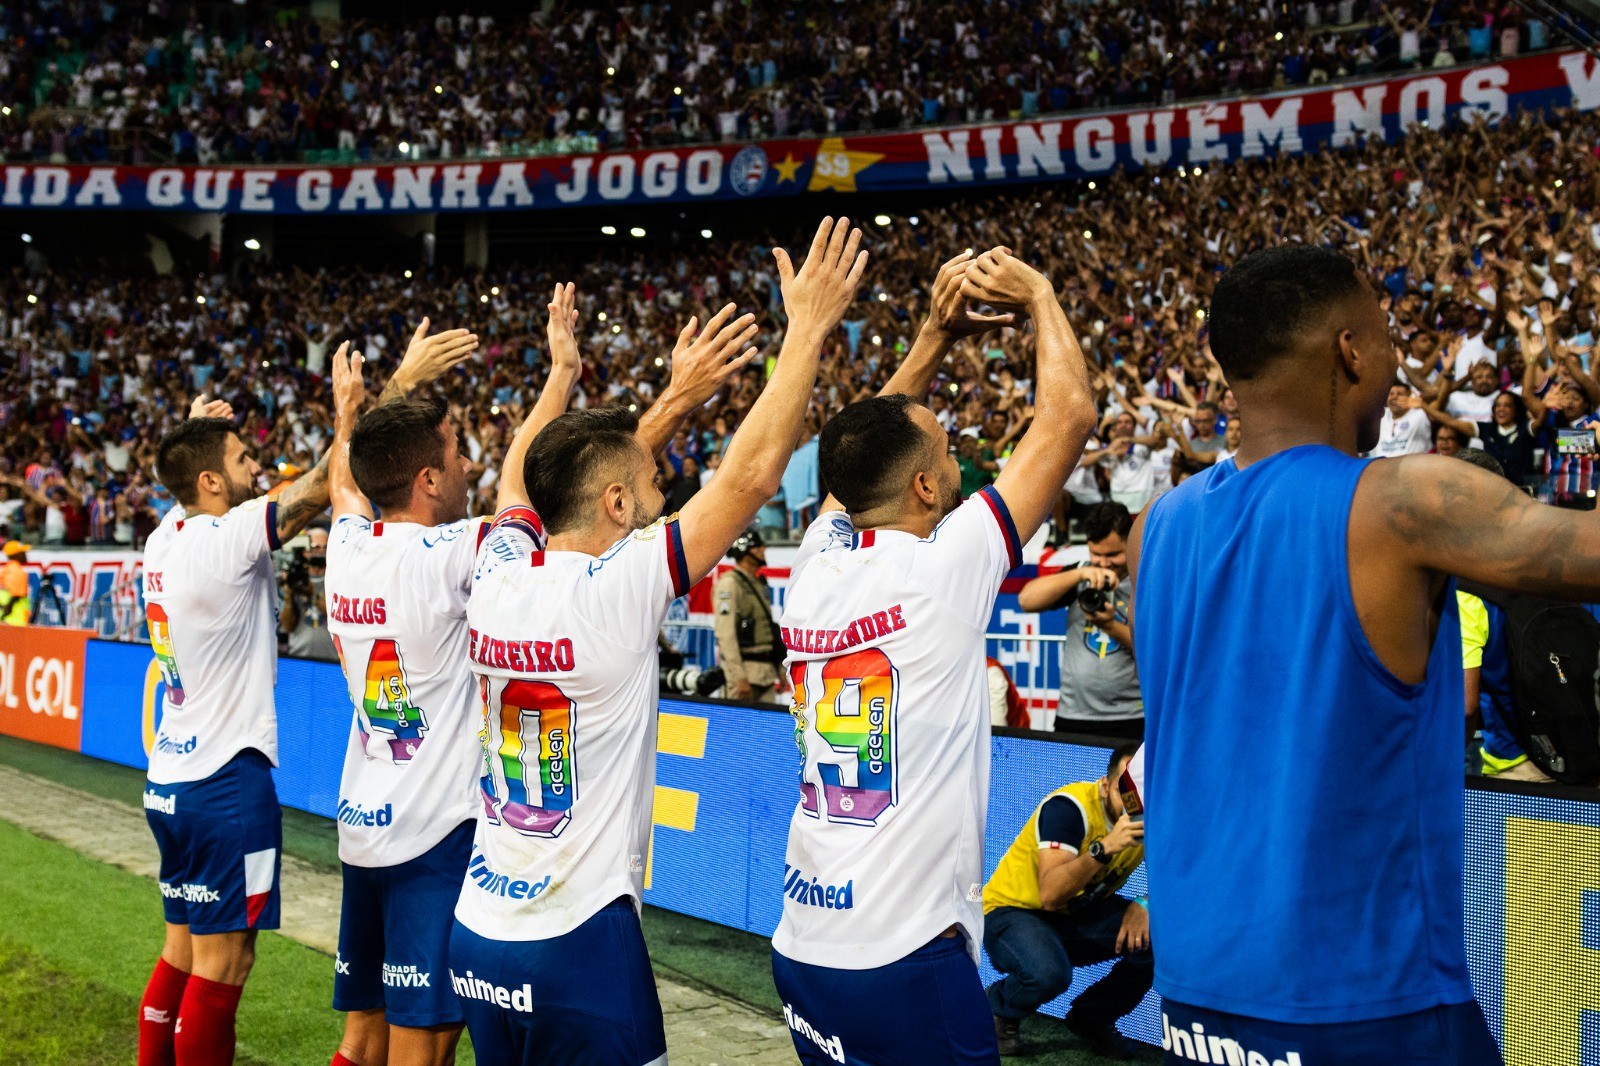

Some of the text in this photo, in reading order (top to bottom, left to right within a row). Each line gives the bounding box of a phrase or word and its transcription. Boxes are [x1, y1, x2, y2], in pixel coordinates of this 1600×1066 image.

[926, 99, 1303, 183] NINGUÉM
[1331, 65, 1510, 148] NOS
[146, 168, 278, 211] QUE
[296, 163, 534, 211] GANHA
[554, 149, 724, 203] JOGO
[815, 152, 850, 178] 59
[330, 592, 387, 625] CARLOS
[478, 634, 576, 673] RIBEIRO
[25, 656, 79, 720] GOL
[389, 676, 410, 728] acelen
[548, 728, 565, 796] acelen
[867, 697, 885, 775] acelen
[142, 789, 176, 815] nimed
